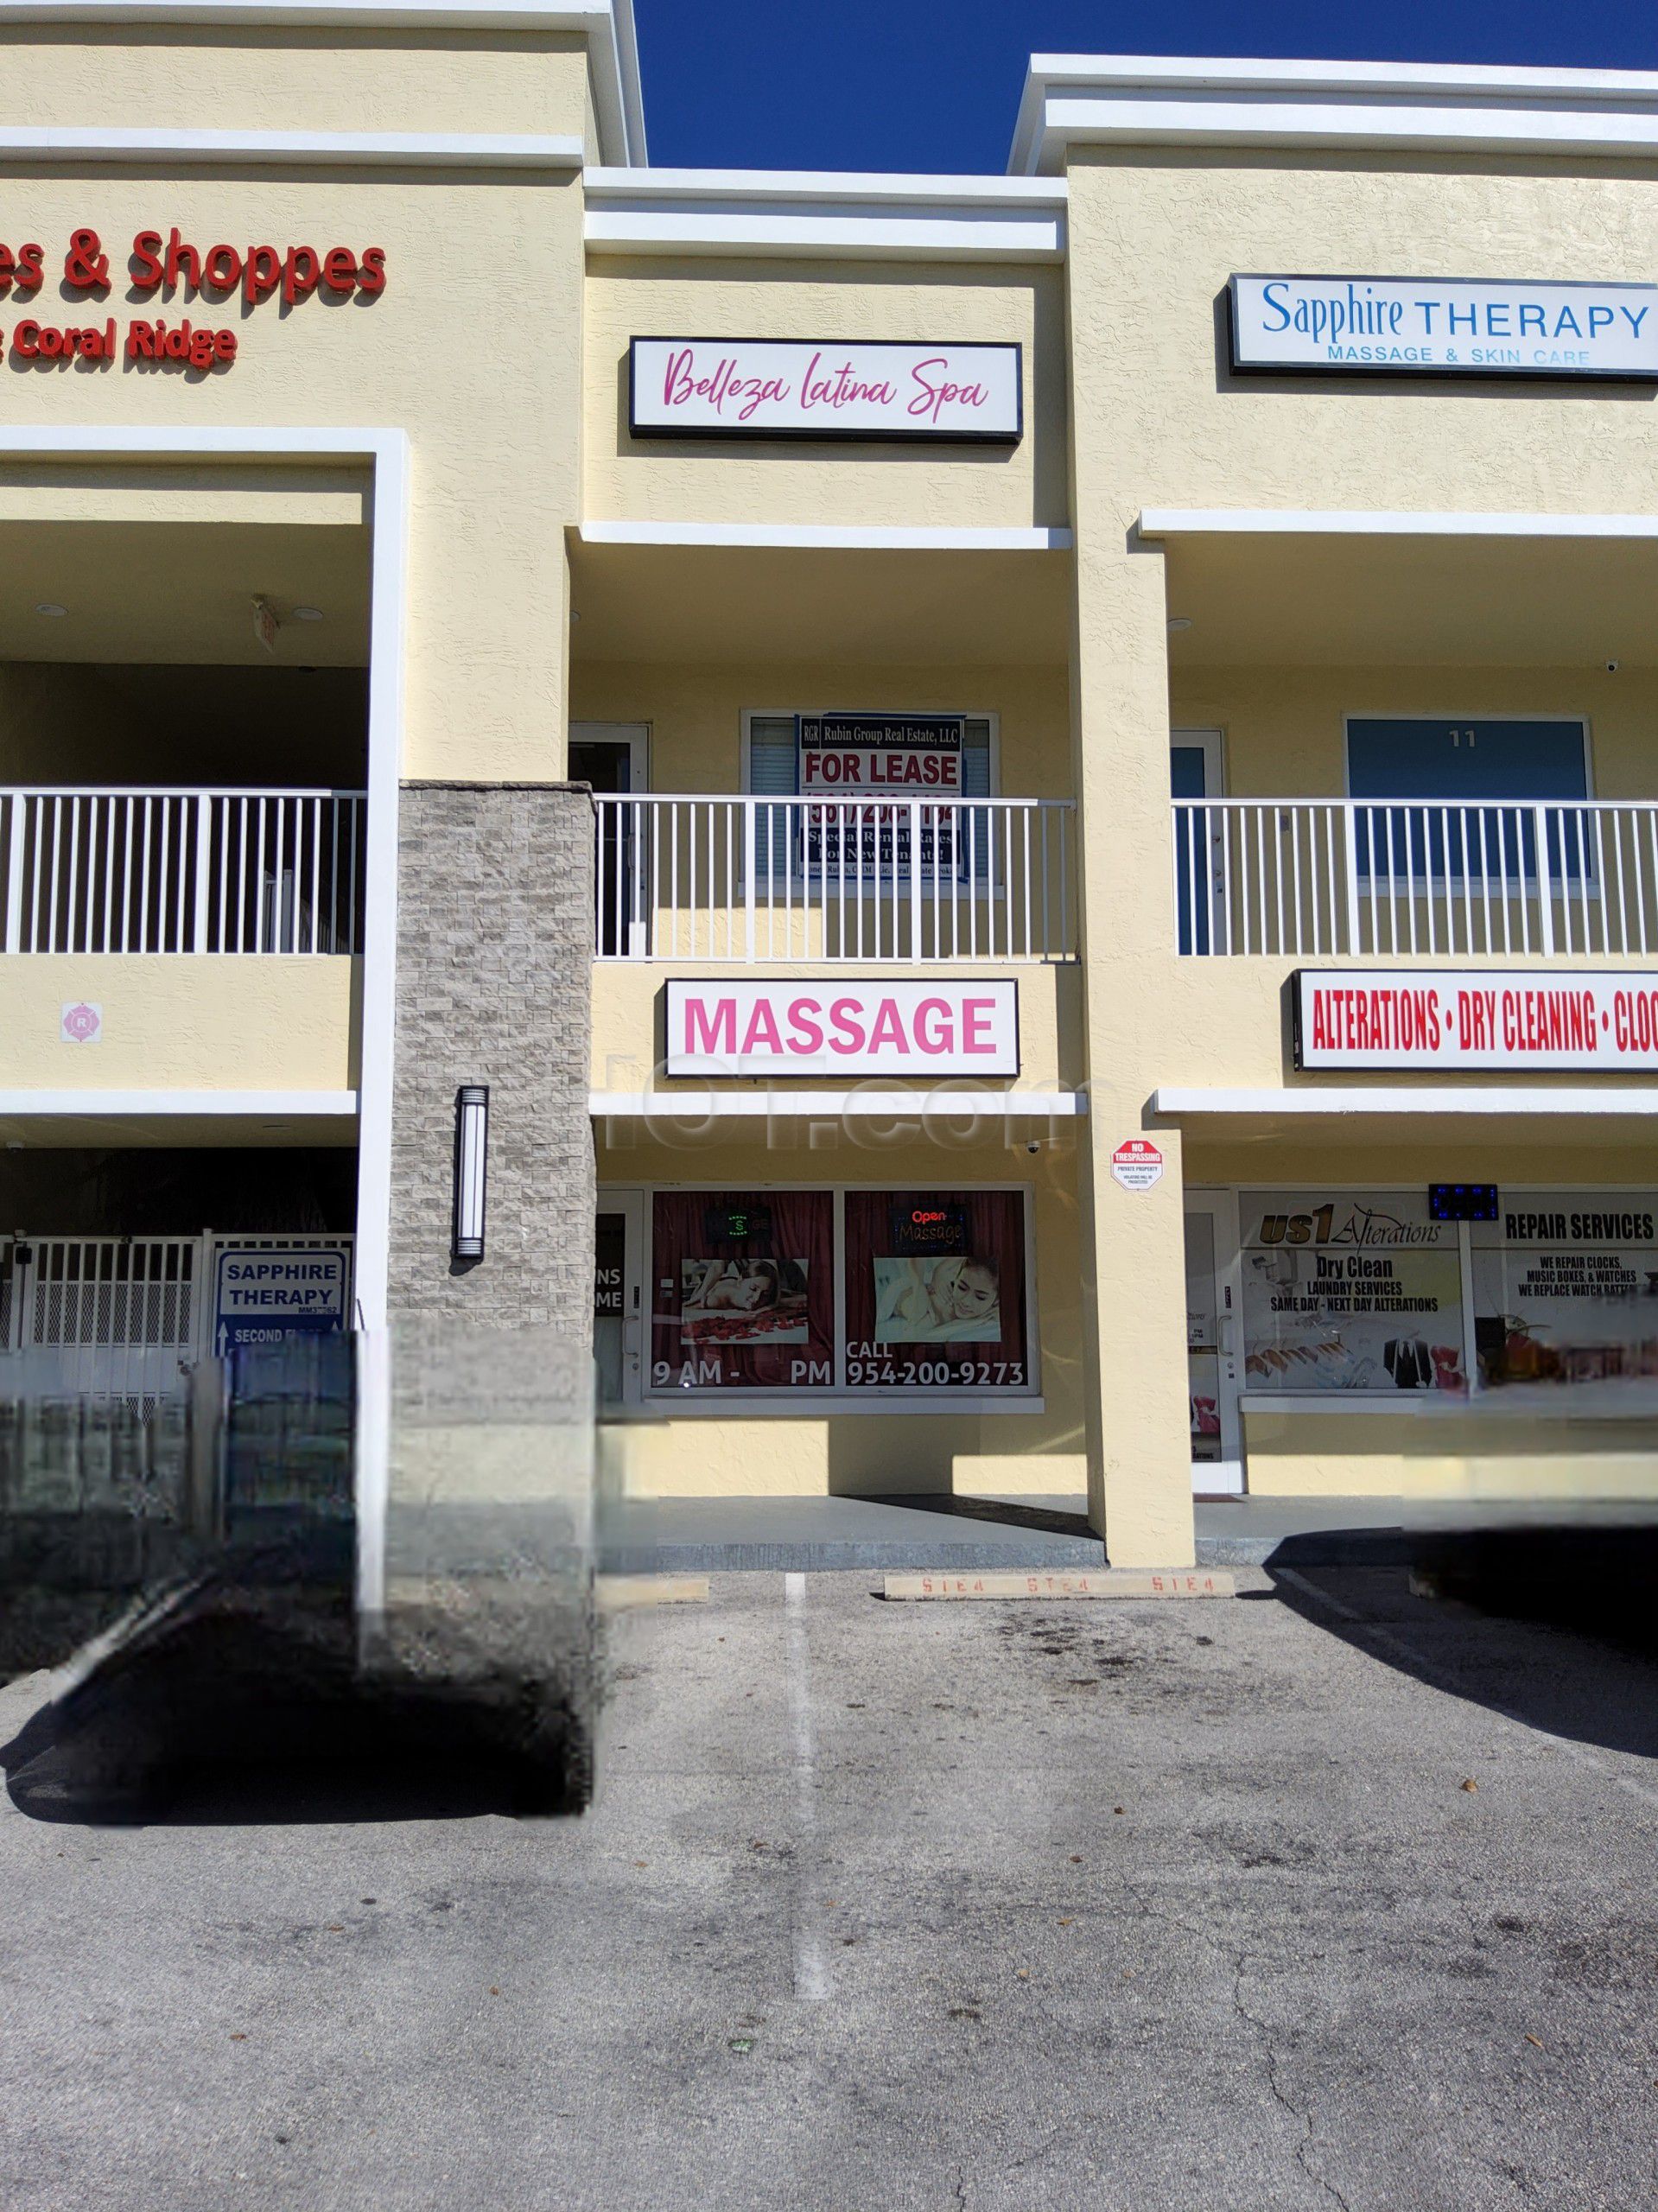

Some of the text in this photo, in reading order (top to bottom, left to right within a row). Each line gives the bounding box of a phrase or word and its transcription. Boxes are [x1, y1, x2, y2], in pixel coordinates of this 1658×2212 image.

[65, 228, 111, 290] &
[130, 227, 386, 305] Shoppes
[1261, 283, 1651, 344] Sapphire THERAPY
[12, 318, 117, 359] Coral
[128, 318, 238, 370] Ridge
[1327, 346, 1591, 366] MASSAGE & SKIN CARE
[664, 348, 790, 421] Belleza
[906, 358, 989, 423] Spa
[824, 726, 852, 741] Rubin
[854, 726, 883, 746] Group
[885, 727, 905, 742] Real
[907, 728, 937, 746] Estate,
[939, 728, 958, 743] LLC
[805, 753, 957, 785] FOR LEASE
[77, 1017, 86, 1027] R
[683, 997, 997, 1055] MASSAGE
[1312, 988, 1440, 1052] ALTERATIONS
[1458, 990, 1496, 1051] DRY
[1502, 990, 1598, 1052] CLEANING
[1115, 1153, 1161, 1162] TRESPASSING
[1131, 1142, 1145, 1153] NO
[912, 1211, 947, 1225] Open
[1505, 1213, 1655, 1240] REPAIR SERVICES
[899, 1224, 962, 1245] Massage
[227, 1264, 337, 1280] SAPPHIRE
[1317, 1255, 1393, 1280] Dry Clean
[1540, 1256, 1554, 1268] WE
[1556, 1256, 1585, 1269] REPAIR
[1527, 1270, 1555, 1282] MUSIC
[1588, 1272, 1595, 1282] &
[1595, 1270, 1636, 1283] WATCHES
[229, 1289, 334, 1306] THERAPY
[1307, 1281, 1402, 1295] LAUNDRY SERVICES
[1518, 1284, 1533, 1296] WE
[1534, 1284, 1570, 1296] REPLACE
[1571, 1284, 1602, 1296] WATCH
[1270, 1297, 1299, 1312] SAME
[1300, 1297, 1320, 1312] DAY
[1327, 1297, 1351, 1312] NEXT
[1353, 1297, 1373, 1312] DAY
[1374, 1297, 1439, 1312] ALTERATIONS
[234, 1328, 283, 1344] SECOND
[846, 1341, 893, 1358] CALL
[653, 1360, 670, 1386] 9
[678, 1360, 721, 1384] AM
[791, 1360, 831, 1384] PM
[848, 1362, 1024, 1385] 954-200-9273
